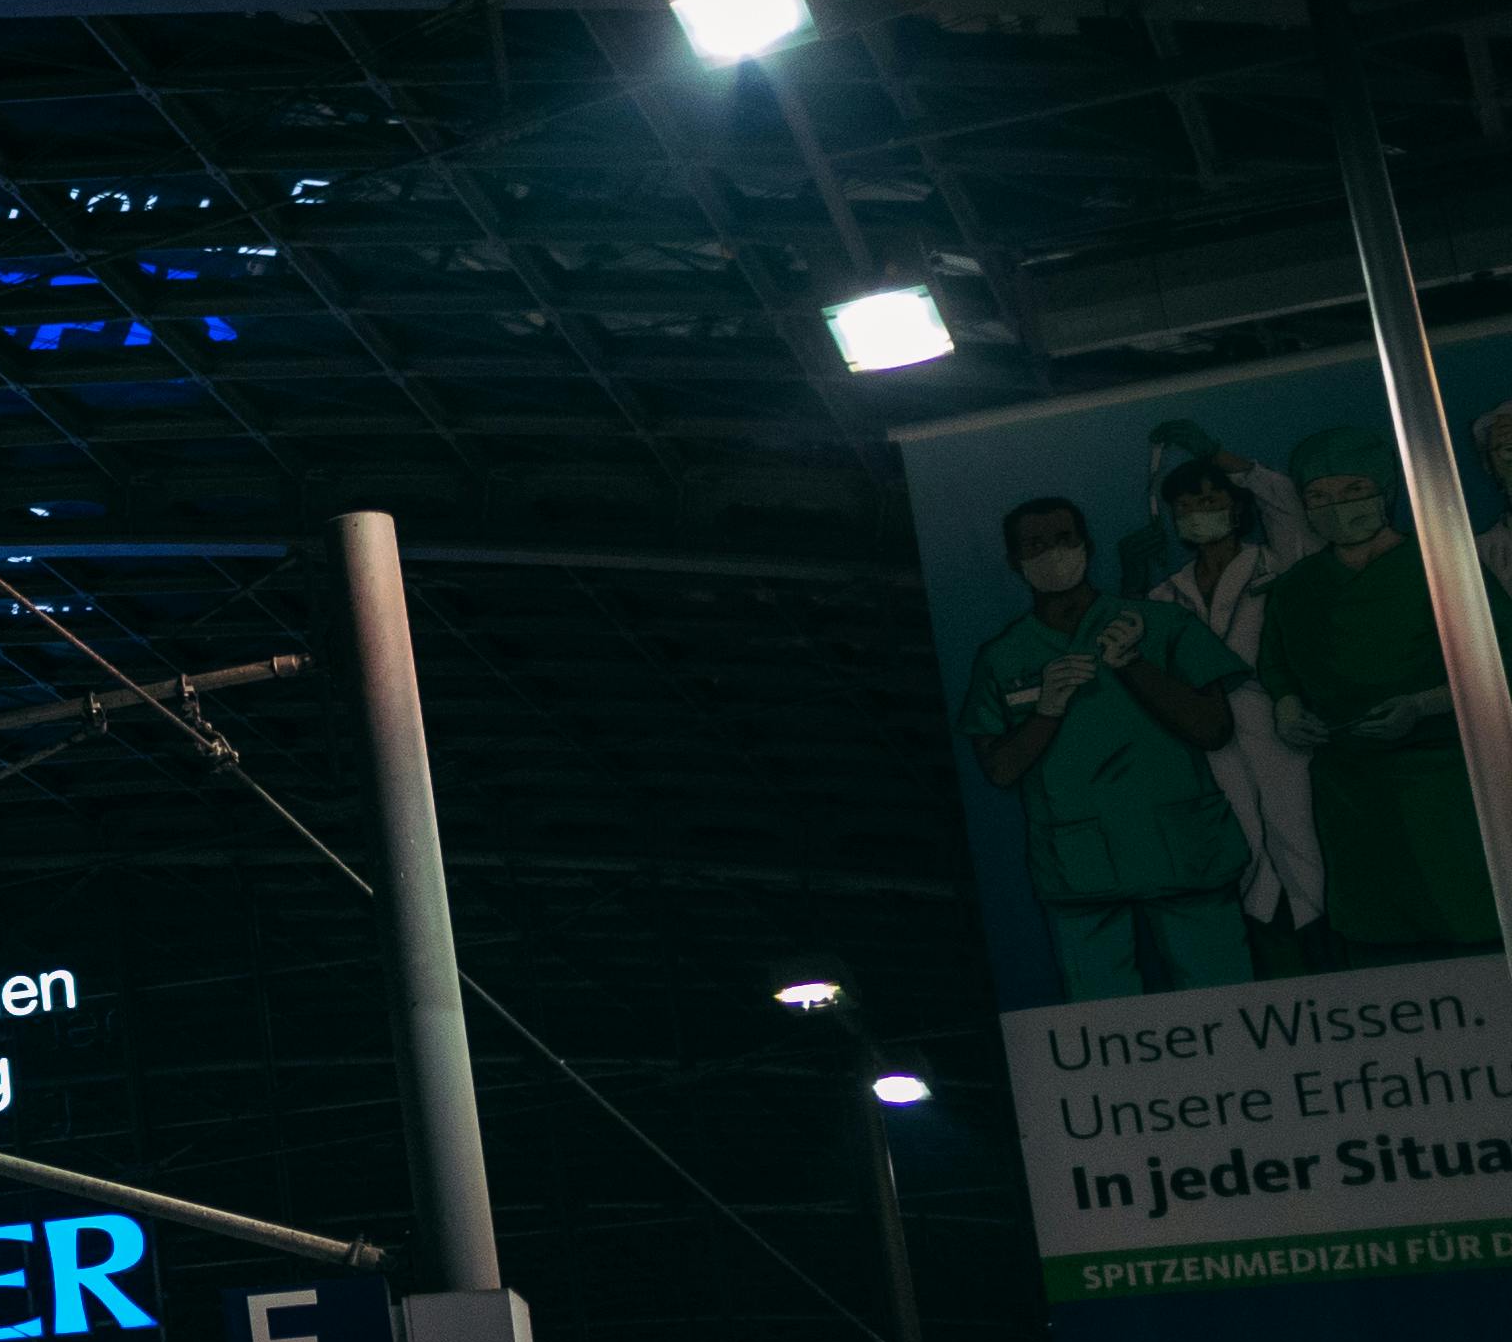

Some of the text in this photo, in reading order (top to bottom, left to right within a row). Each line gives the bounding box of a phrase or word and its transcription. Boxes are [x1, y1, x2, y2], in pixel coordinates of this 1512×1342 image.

[1048, 993, 1486, 1071] Unser Wissen.
[1060, 1086, 1274, 1140] Unsere
[1071, 1164, 1134, 1211] In
[1147, 1148, 1321, 1219] jeder
[1080, 1239, 1399, 1293] SPITZENMEDIZIN
[1404, 1229, 1484, 1266] FÜR
